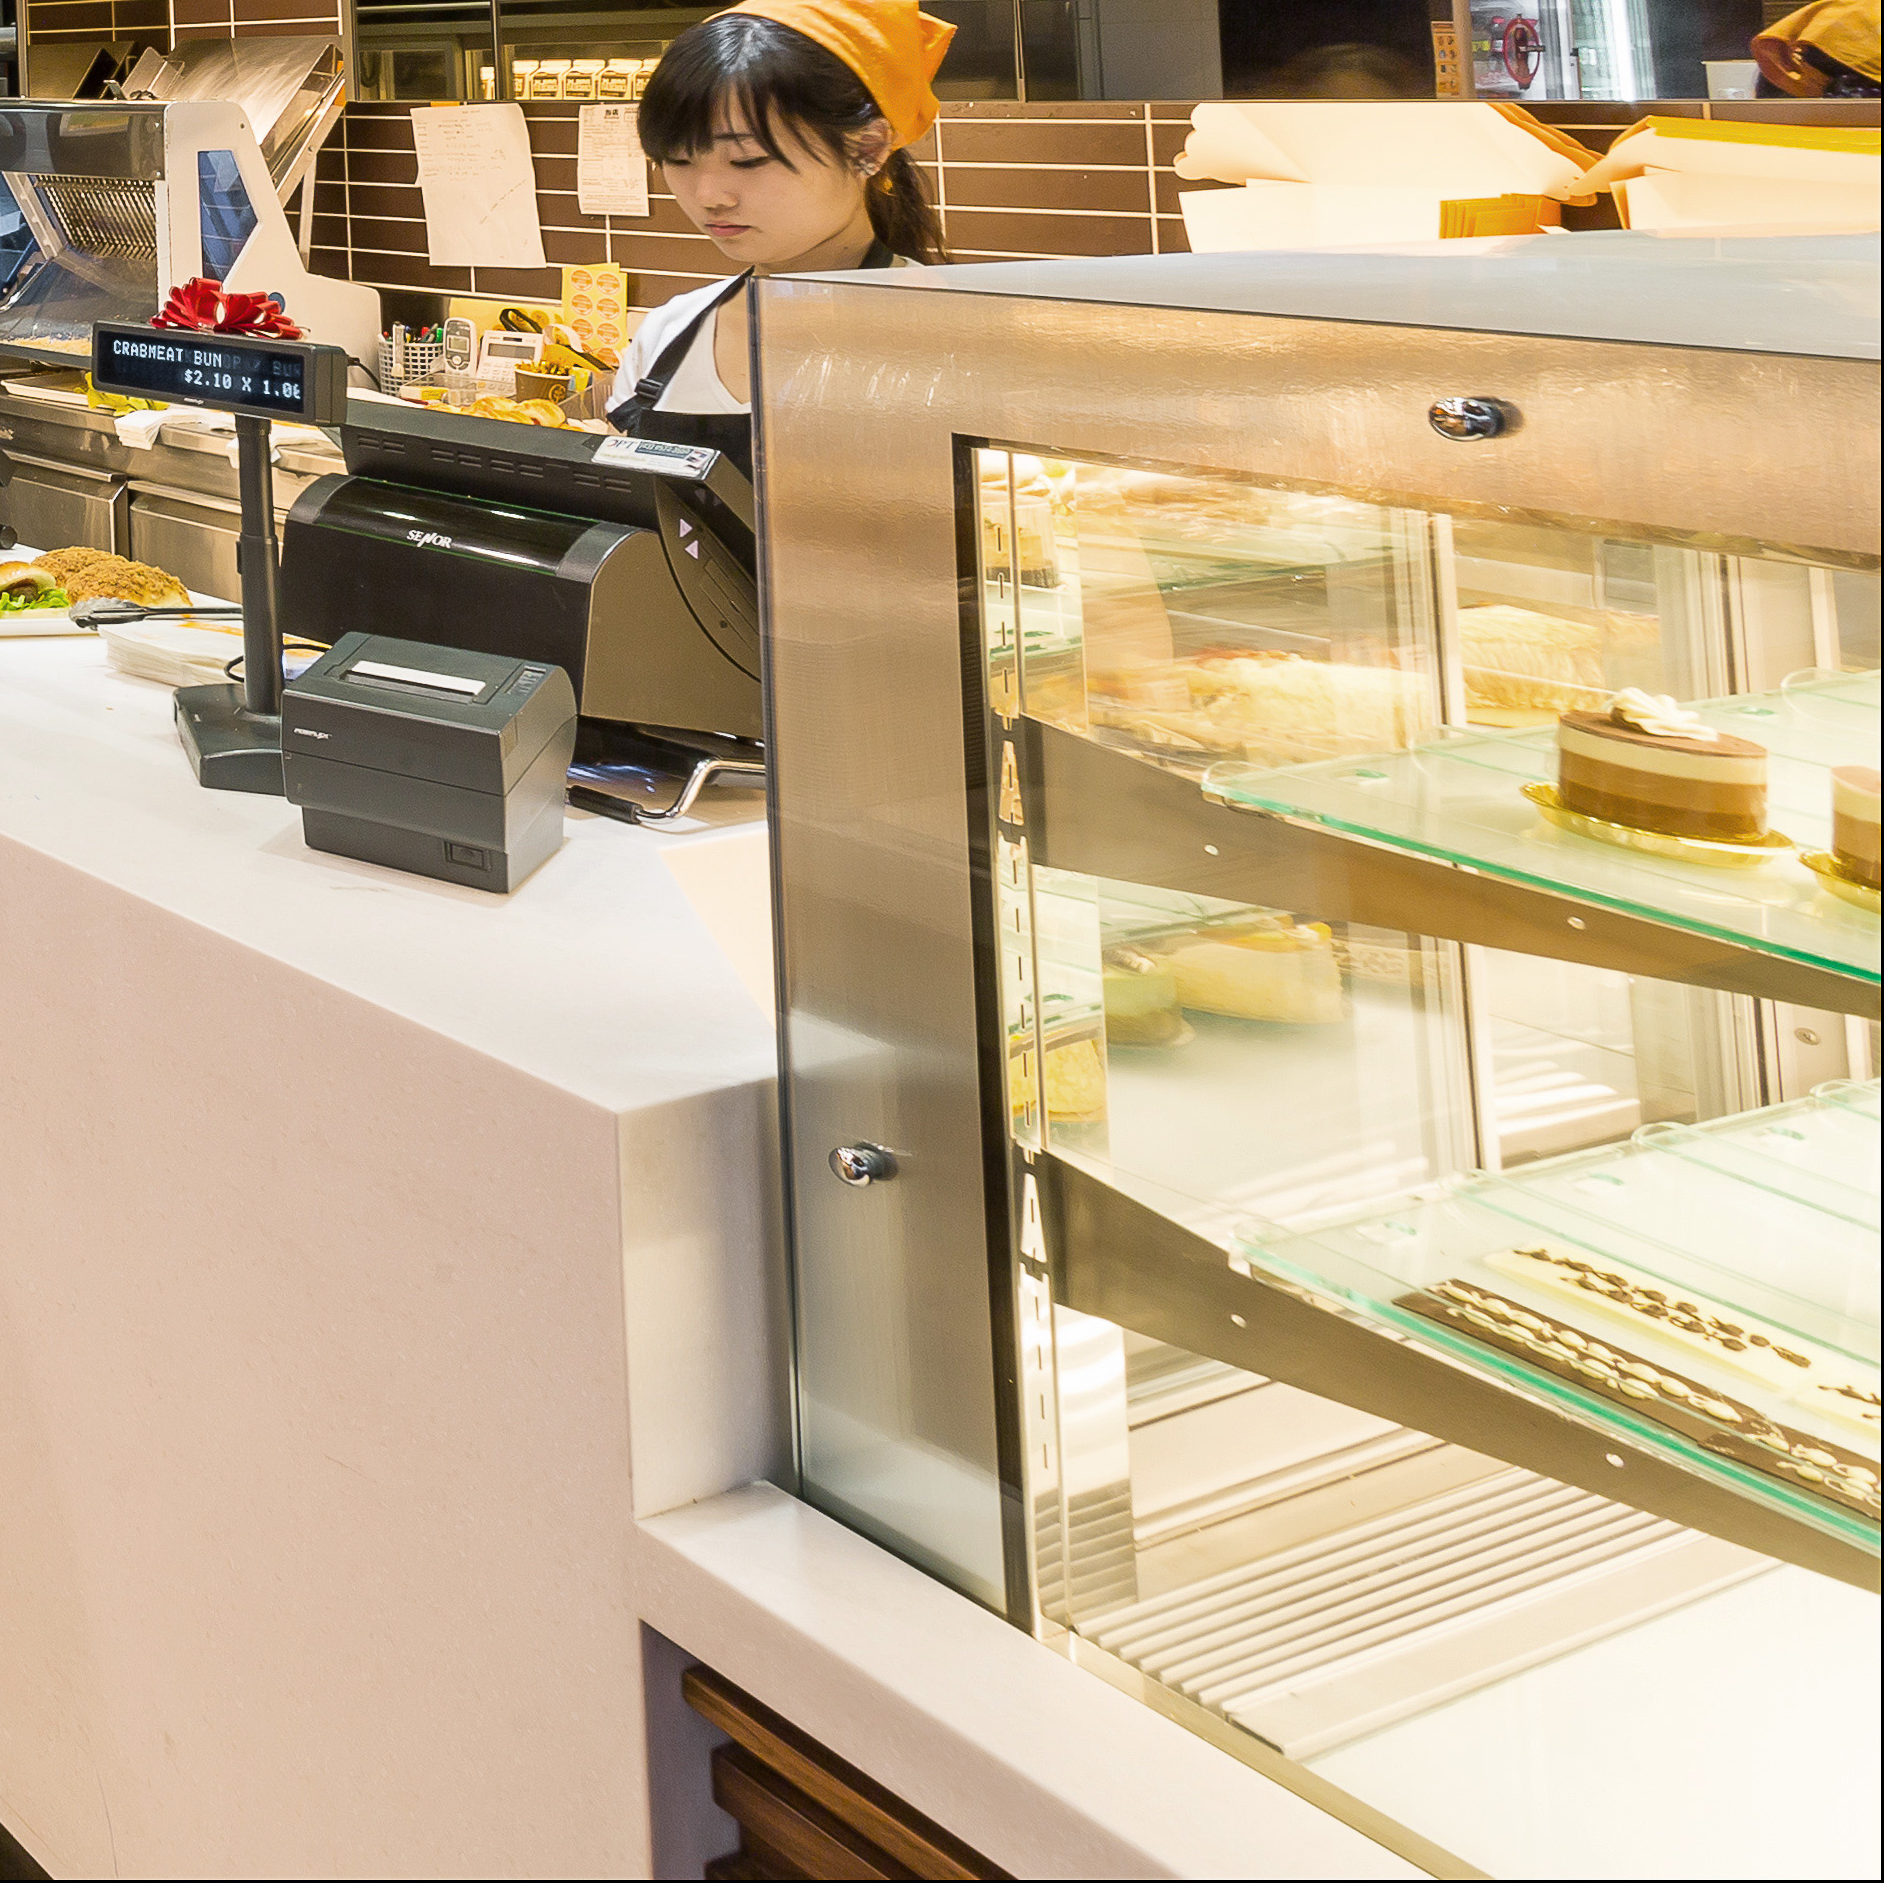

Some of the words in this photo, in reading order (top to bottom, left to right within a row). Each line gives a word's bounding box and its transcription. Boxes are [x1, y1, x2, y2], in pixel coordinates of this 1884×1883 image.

[112, 339, 183, 362] CRABMEAT
[193, 350, 223, 368] BUN
[184, 368, 233, 390] $2.10
[241, 376, 252, 393] X
[406, 529, 453, 549] SENOR
